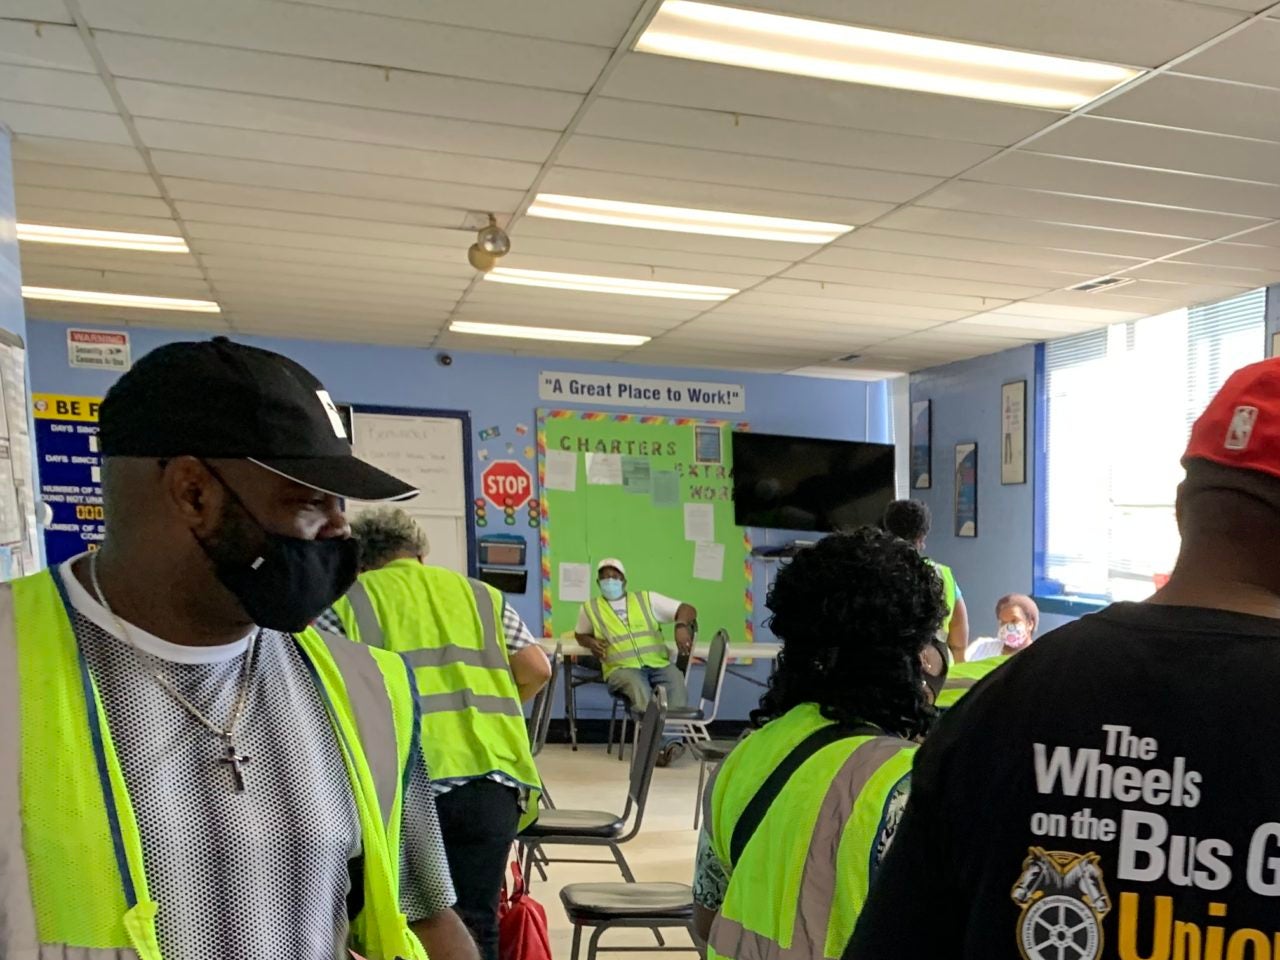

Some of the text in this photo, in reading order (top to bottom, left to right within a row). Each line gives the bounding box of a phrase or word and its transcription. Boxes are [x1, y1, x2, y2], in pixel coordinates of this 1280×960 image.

[569, 379, 611, 397] Great
[618, 383, 660, 401] Place
[667, 387, 681, 402] to
[56, 400, 81, 416] BE
[559, 436, 677, 456] CHARTERS
[487, 475, 528, 495] STOP
[1102, 724, 1158, 760] The
[1033, 743, 1202, 808] Wheels
[1030, 812, 1066, 837] on
[1071, 808, 1117, 841] the
[1117, 809, 1234, 891] Bus
